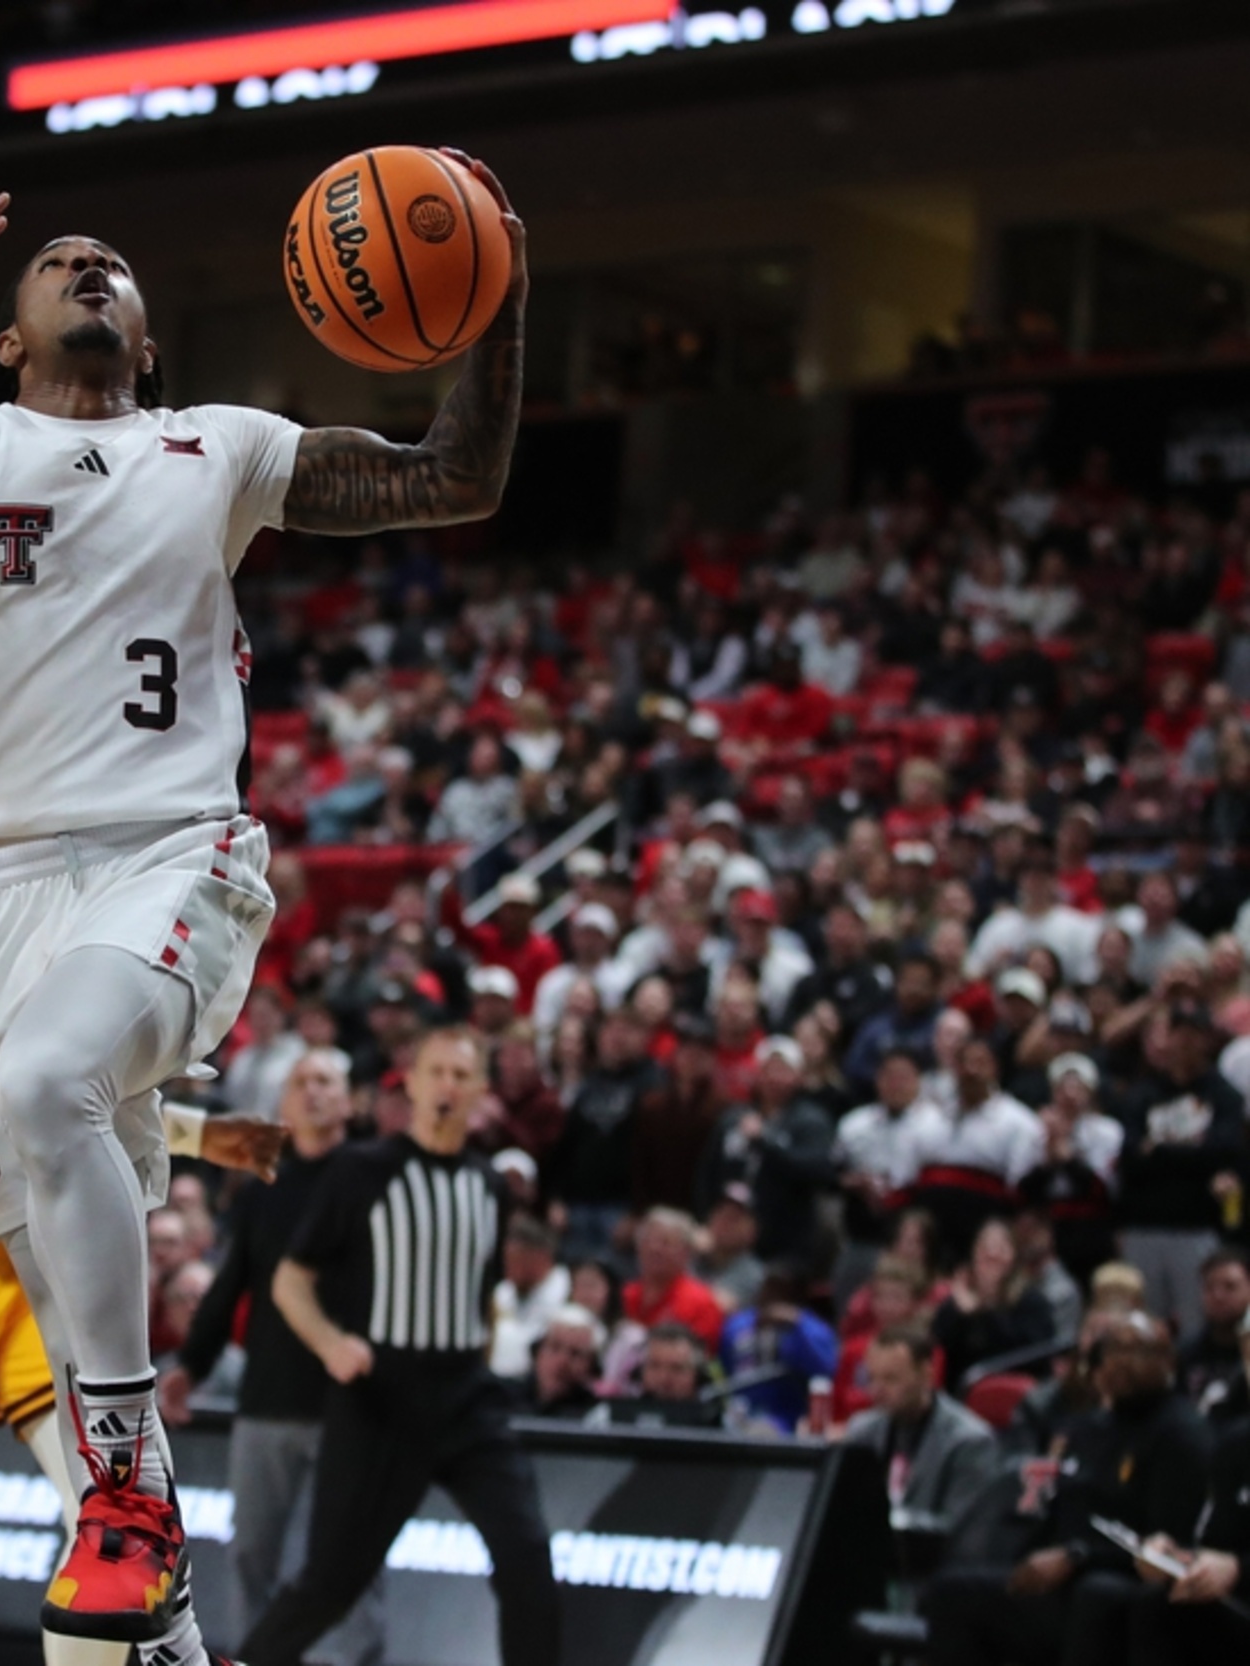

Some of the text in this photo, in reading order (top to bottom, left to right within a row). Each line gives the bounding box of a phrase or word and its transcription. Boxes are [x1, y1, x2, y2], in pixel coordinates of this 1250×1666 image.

[287, 222, 327, 326] NCAA
[325, 170, 386, 322] Wilson
[123, 637, 178, 732] 3
